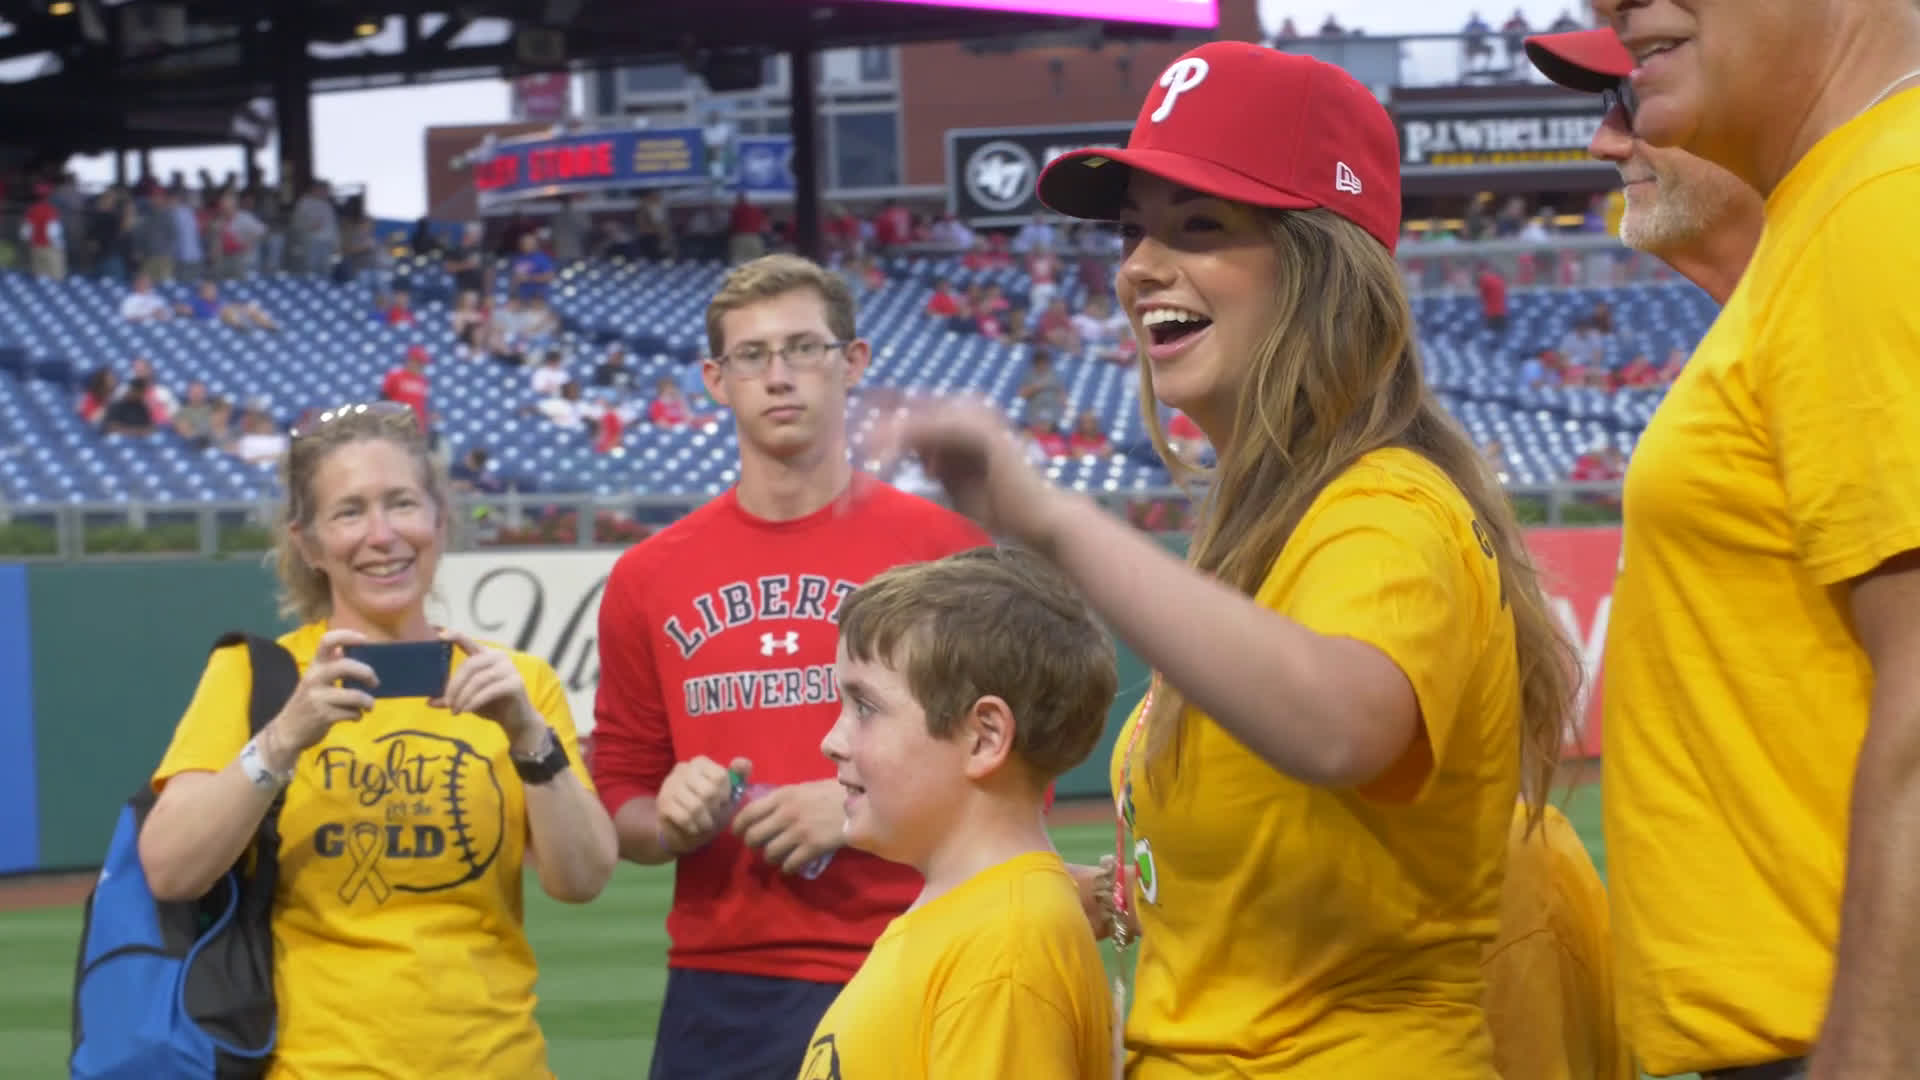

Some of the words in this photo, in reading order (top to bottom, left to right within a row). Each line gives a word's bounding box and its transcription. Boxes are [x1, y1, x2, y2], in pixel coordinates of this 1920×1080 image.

[1151, 57, 1209, 123] P
[664, 574, 859, 660] LIBERT
[684, 663, 839, 718] UNIVERSI
[315, 739, 442, 806] Fight
